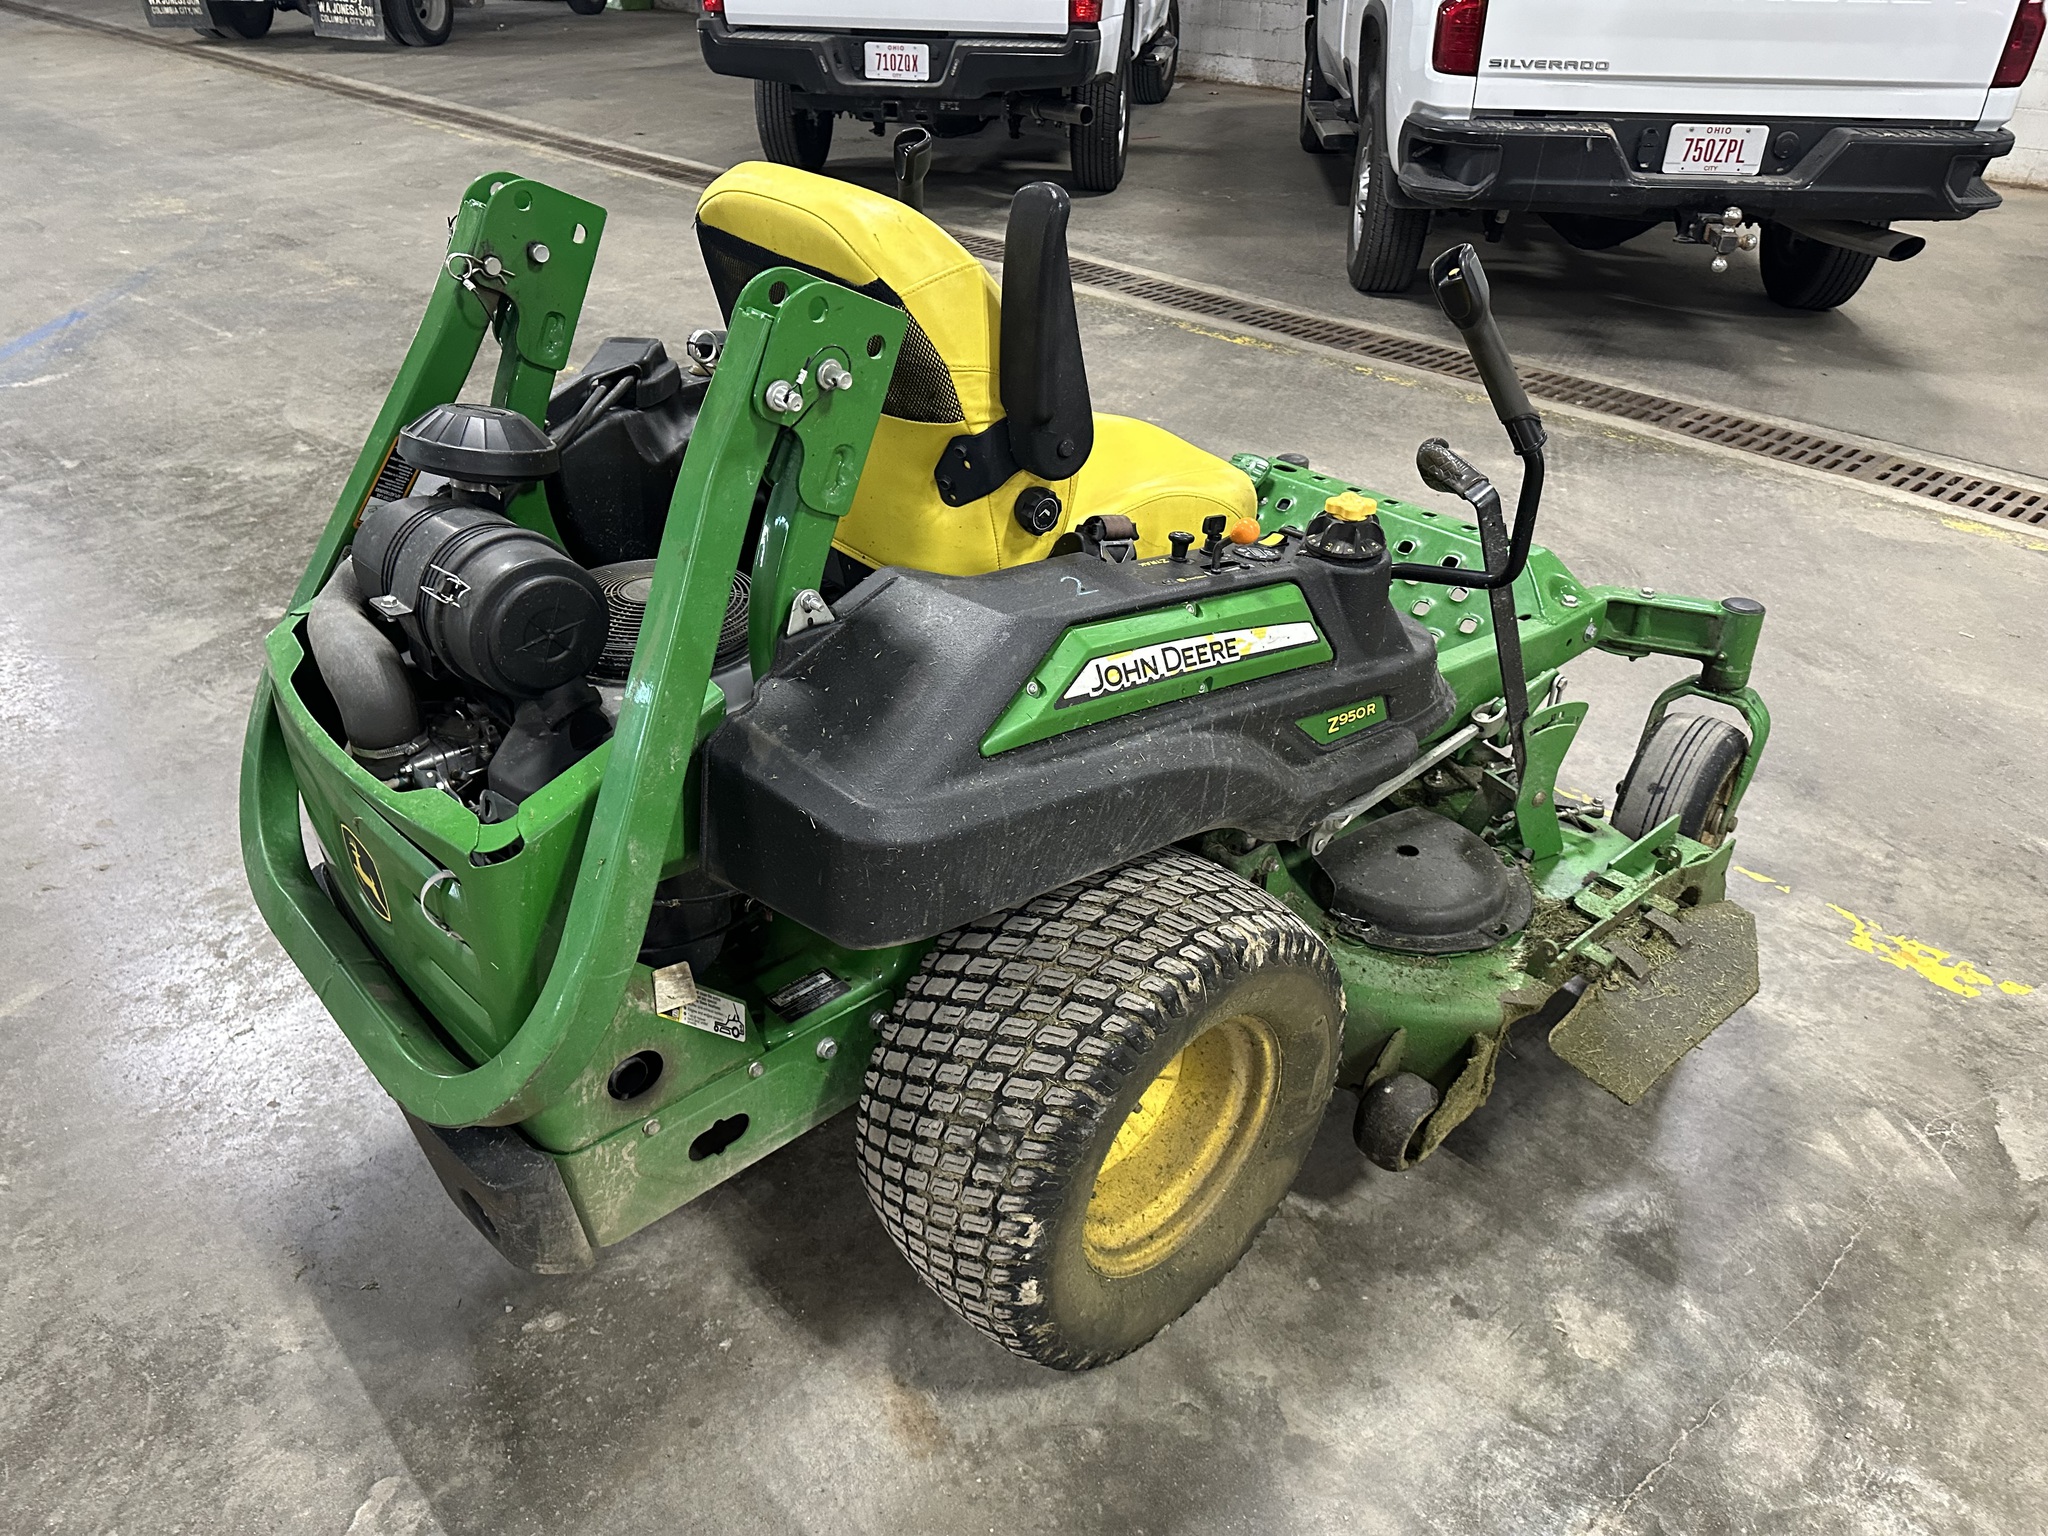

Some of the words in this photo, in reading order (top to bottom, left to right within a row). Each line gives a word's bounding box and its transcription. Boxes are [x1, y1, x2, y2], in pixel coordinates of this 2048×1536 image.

[875, 53, 918, 72] 710ZQX
[1488, 58, 1610, 71] SILVERADO
[1682, 138, 1745, 163] 750ZPL
[1060, 576, 1099, 597] 2
[1091, 655, 1159, 692] JOHN
[1161, 637, 1240, 672] DEERE
[1327, 703, 1376, 734] Z950R
